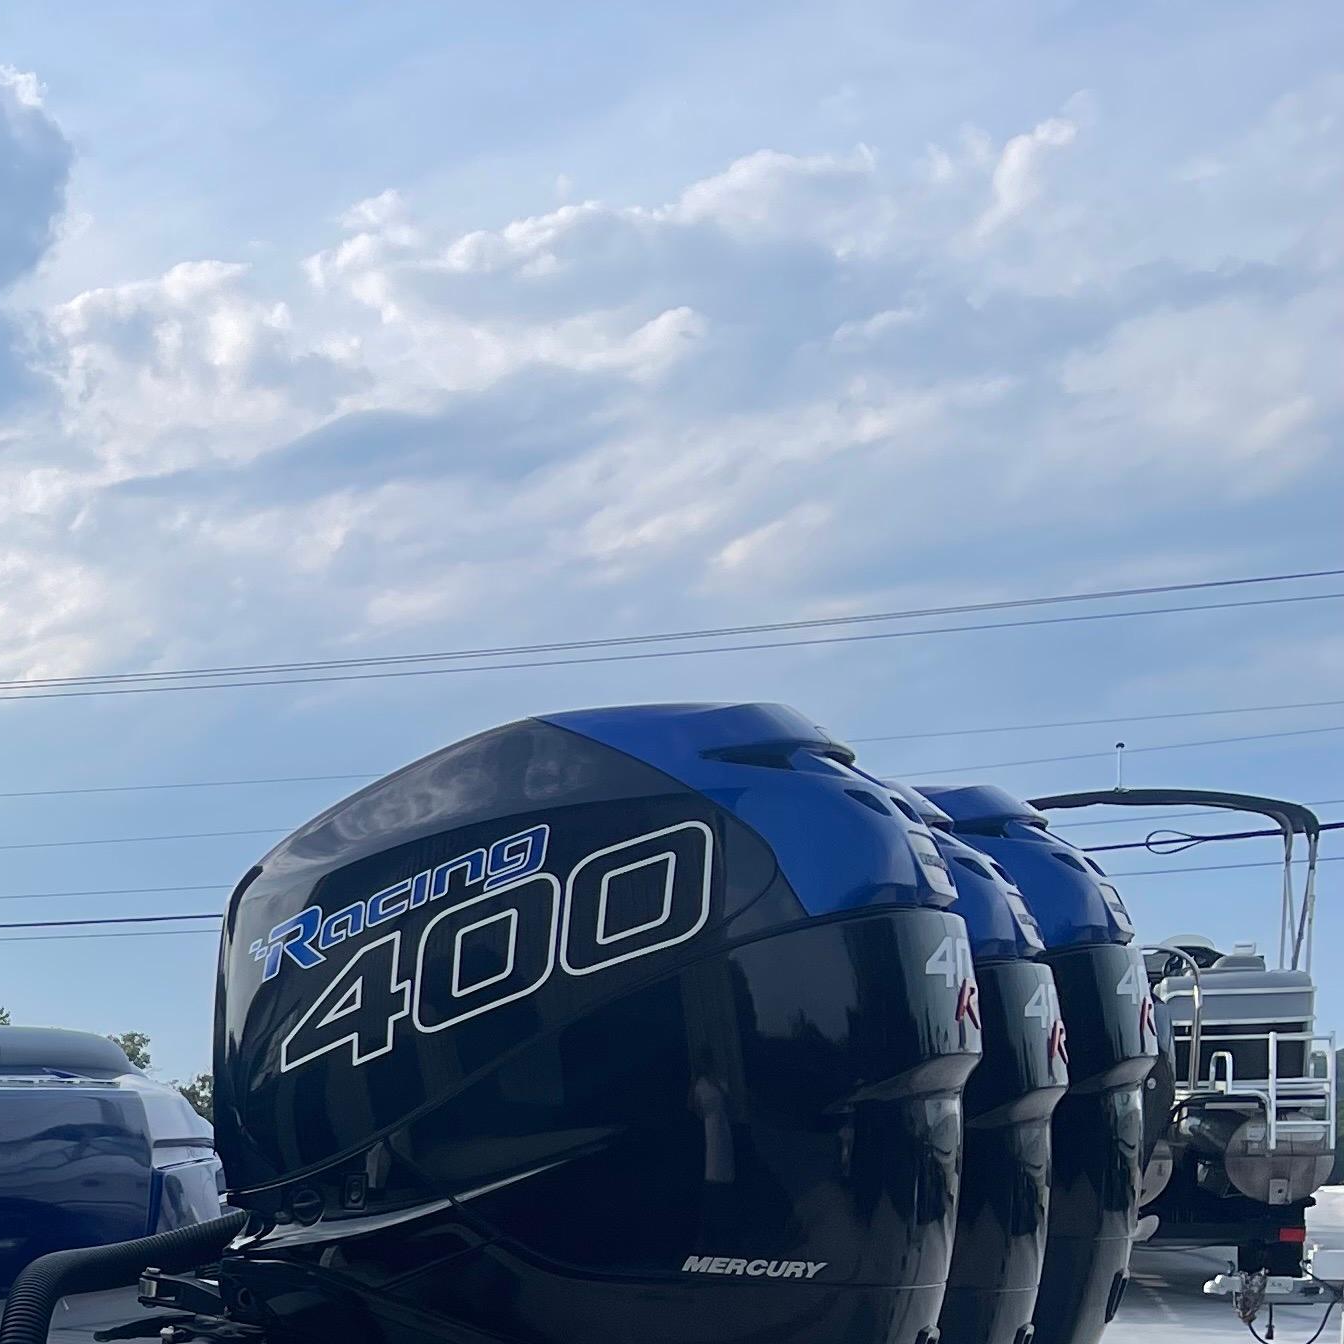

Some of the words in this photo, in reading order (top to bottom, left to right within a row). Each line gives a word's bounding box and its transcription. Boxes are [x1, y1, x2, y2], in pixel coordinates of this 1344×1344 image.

[252, 823, 551, 981] Racing
[281, 820, 714, 1074] 400
[681, 1255, 829, 1279] MERCURY
